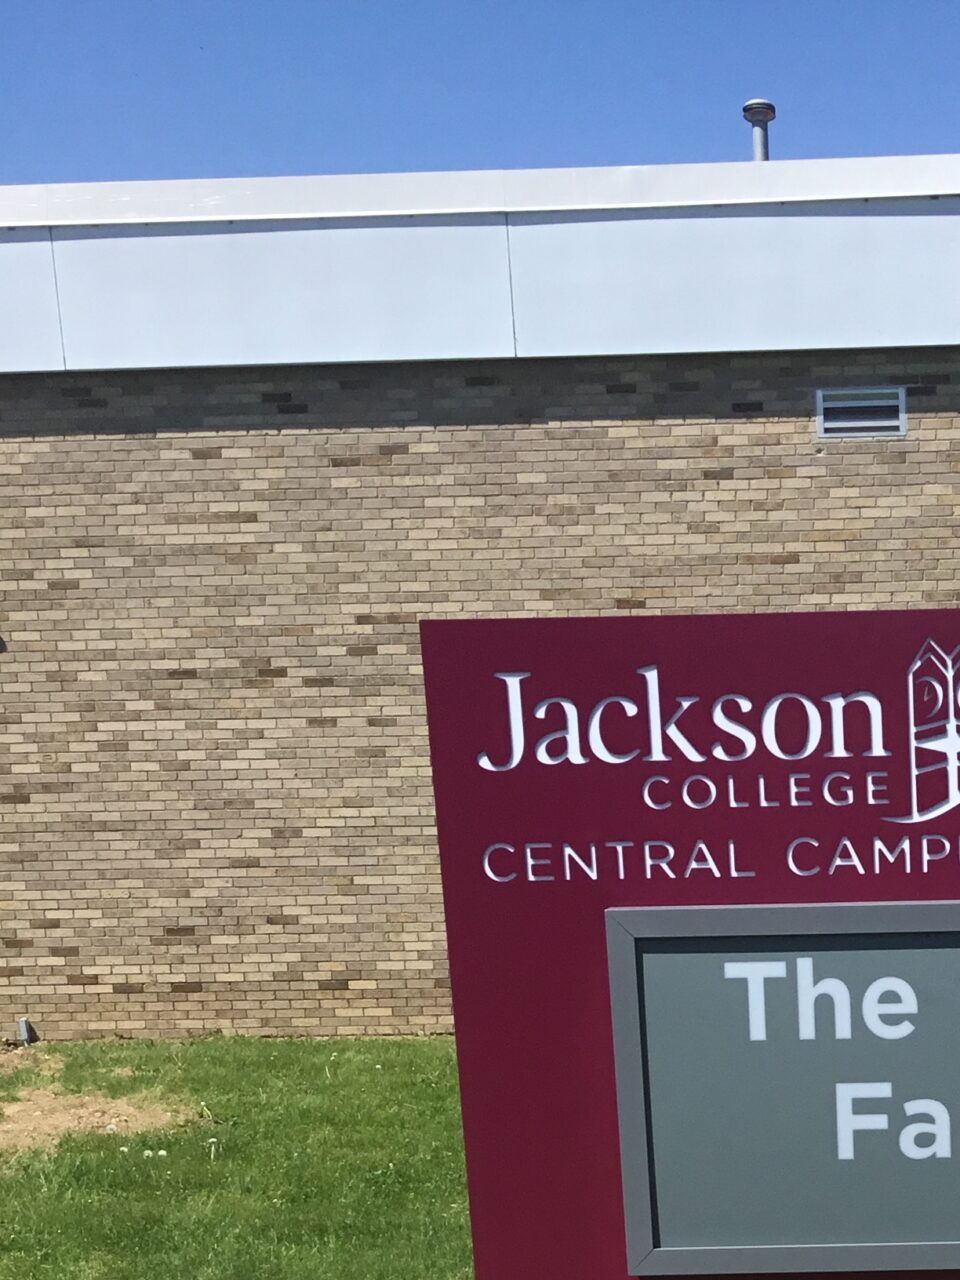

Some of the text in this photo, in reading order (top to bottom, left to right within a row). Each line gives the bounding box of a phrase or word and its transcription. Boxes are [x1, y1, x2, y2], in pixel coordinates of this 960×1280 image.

[478, 665, 891, 772] Jackson
[642, 772, 889, 810] COLLEGE
[483, 841, 756, 883] CENTRAL
[724, 957, 919, 1041] The
